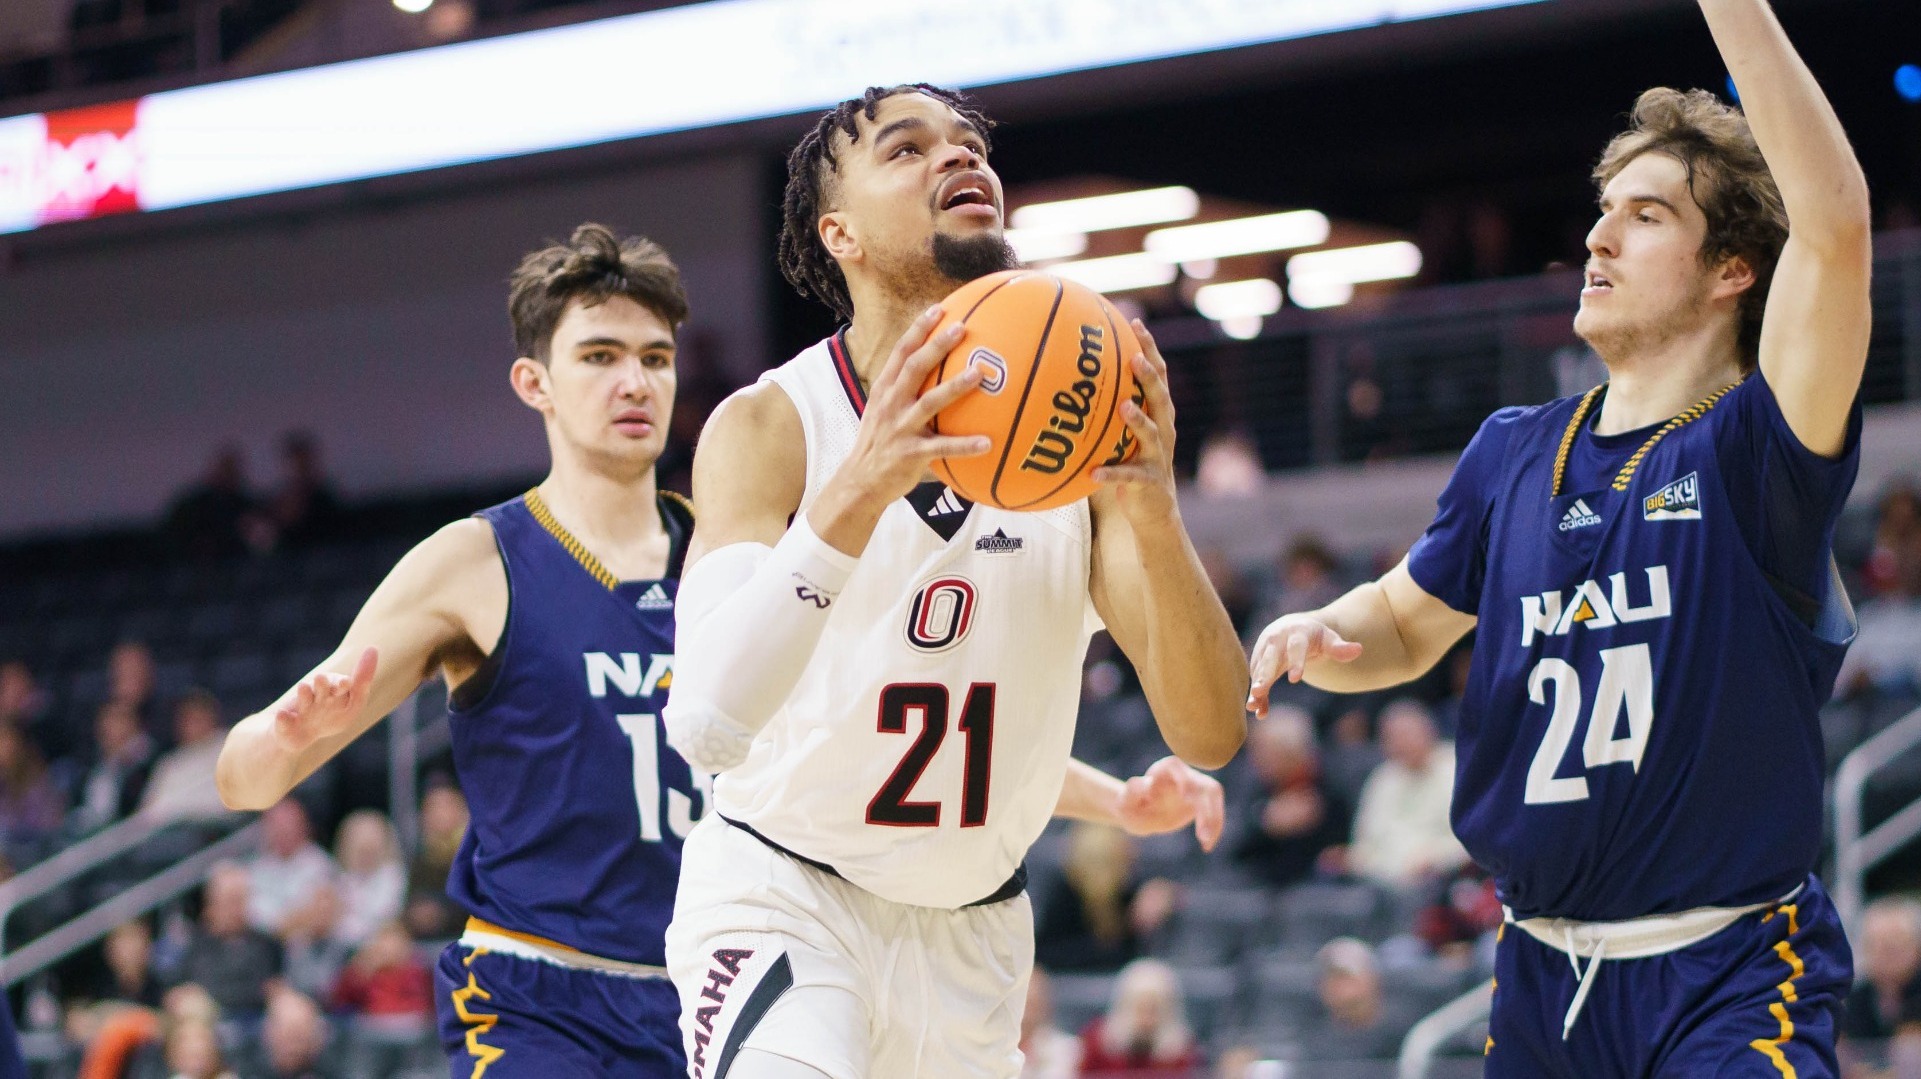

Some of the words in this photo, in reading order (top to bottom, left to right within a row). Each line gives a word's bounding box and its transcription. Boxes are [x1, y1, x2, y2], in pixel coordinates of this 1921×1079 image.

[1019, 323, 1104, 475] Wilson
[975, 538, 1023, 550] SUMMIT
[1558, 514, 1601, 532] adidas
[1520, 565, 1672, 647] NAU
[582, 652, 674, 698] NA
[865, 682, 996, 828] 21
[1524, 642, 1654, 805] 24
